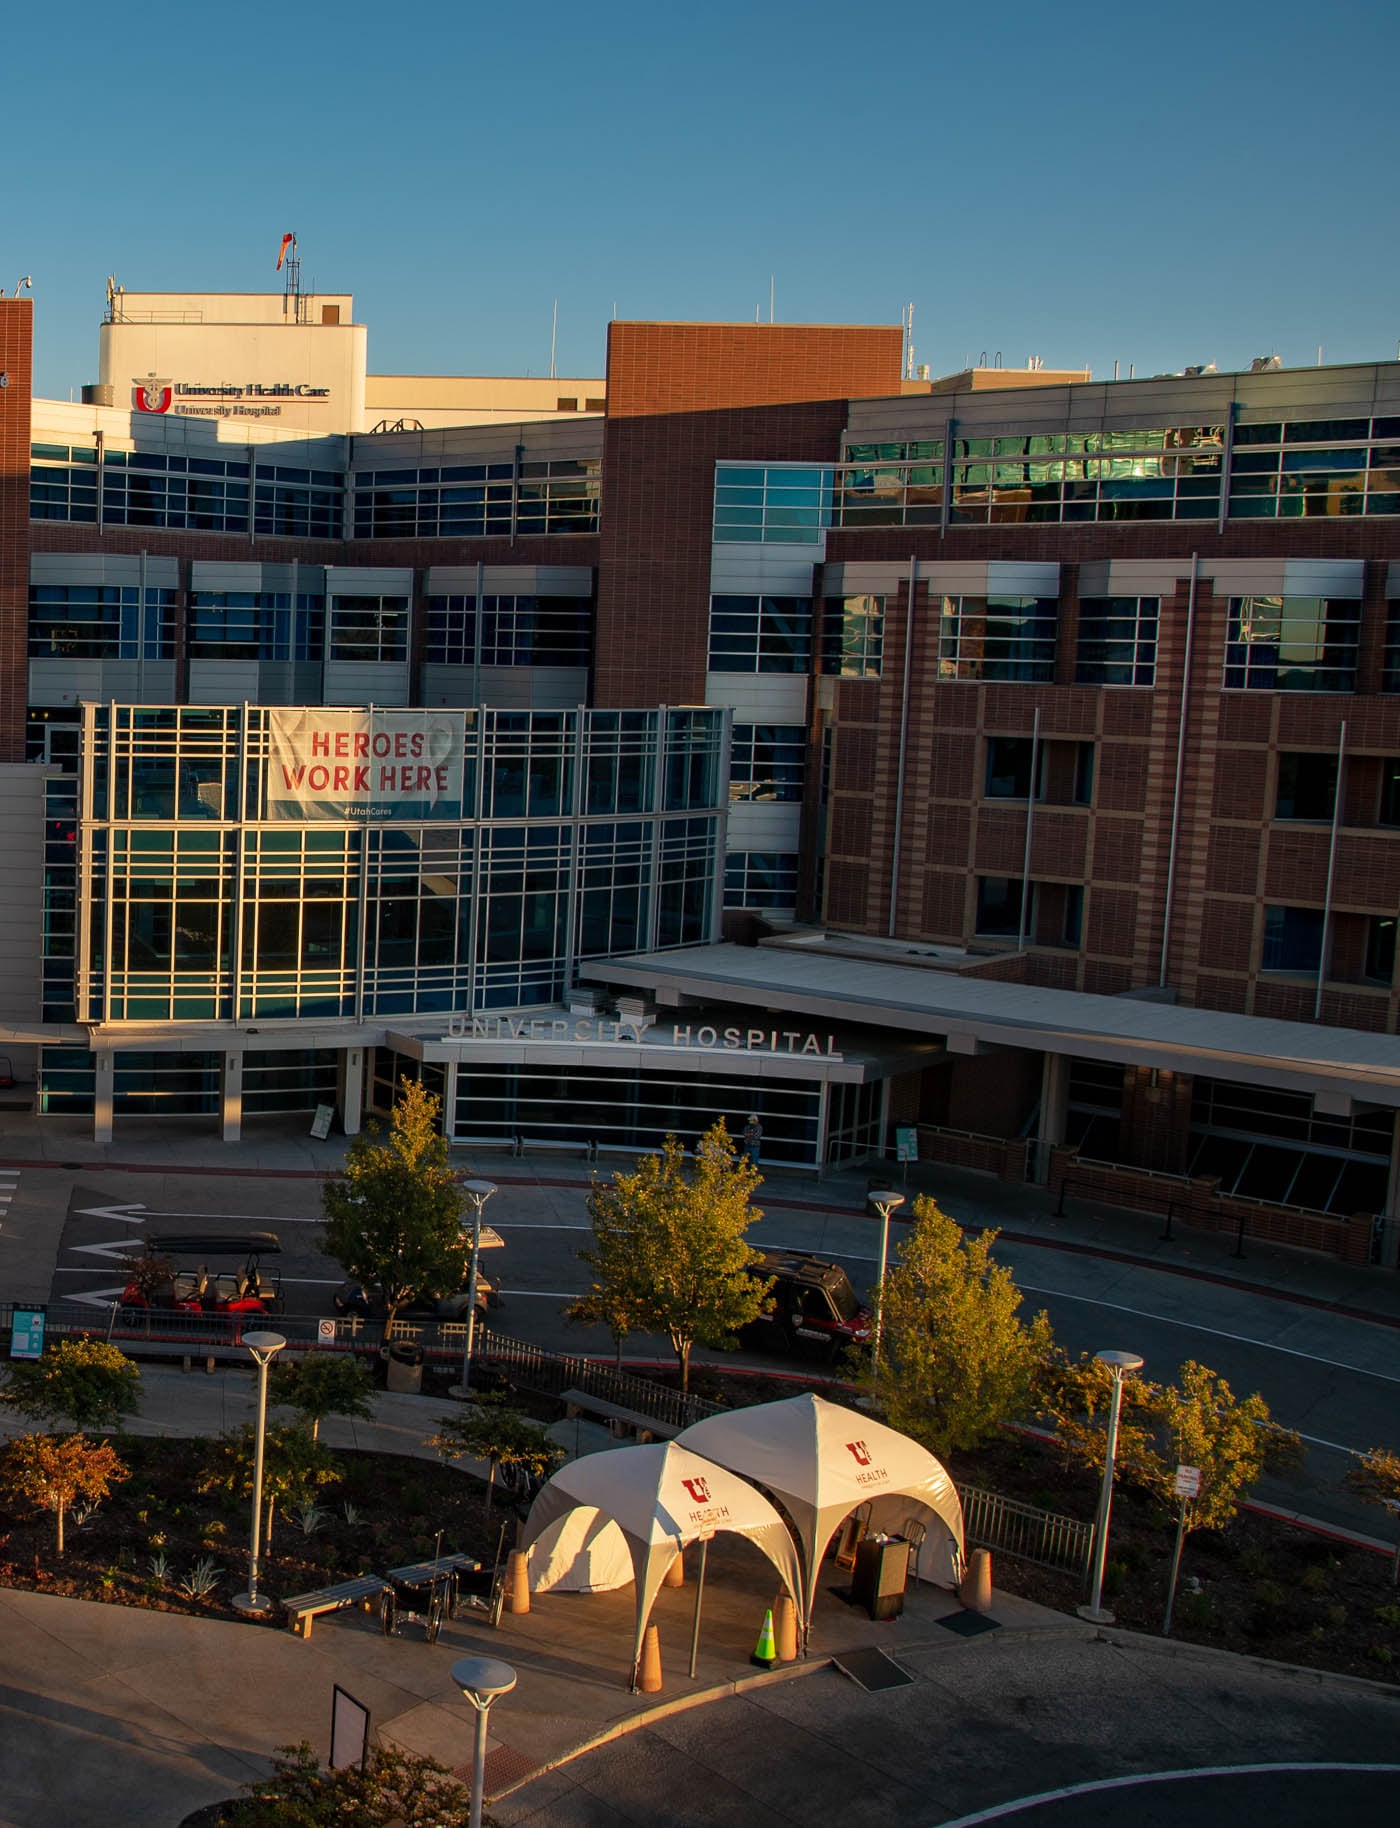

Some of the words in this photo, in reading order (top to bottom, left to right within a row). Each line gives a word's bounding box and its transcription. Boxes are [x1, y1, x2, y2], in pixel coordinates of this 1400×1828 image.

[174, 383, 245, 399] University
[246, 384, 294, 397] Health
[295, 384, 330, 398] Care
[174, 405, 232, 417] University
[233, 406, 281, 418] Hospital
[312, 731, 425, 758] HEROES
[282, 765, 371, 792] WORK
[380, 765, 449, 792] HERE
[344, 807, 392, 816] #UtahCares
[449, 1017, 649, 1043] UNIVERSITY
[673, 1025, 843, 1057] HOSPITAL
[856, 1468, 888, 1484] HEALTH
